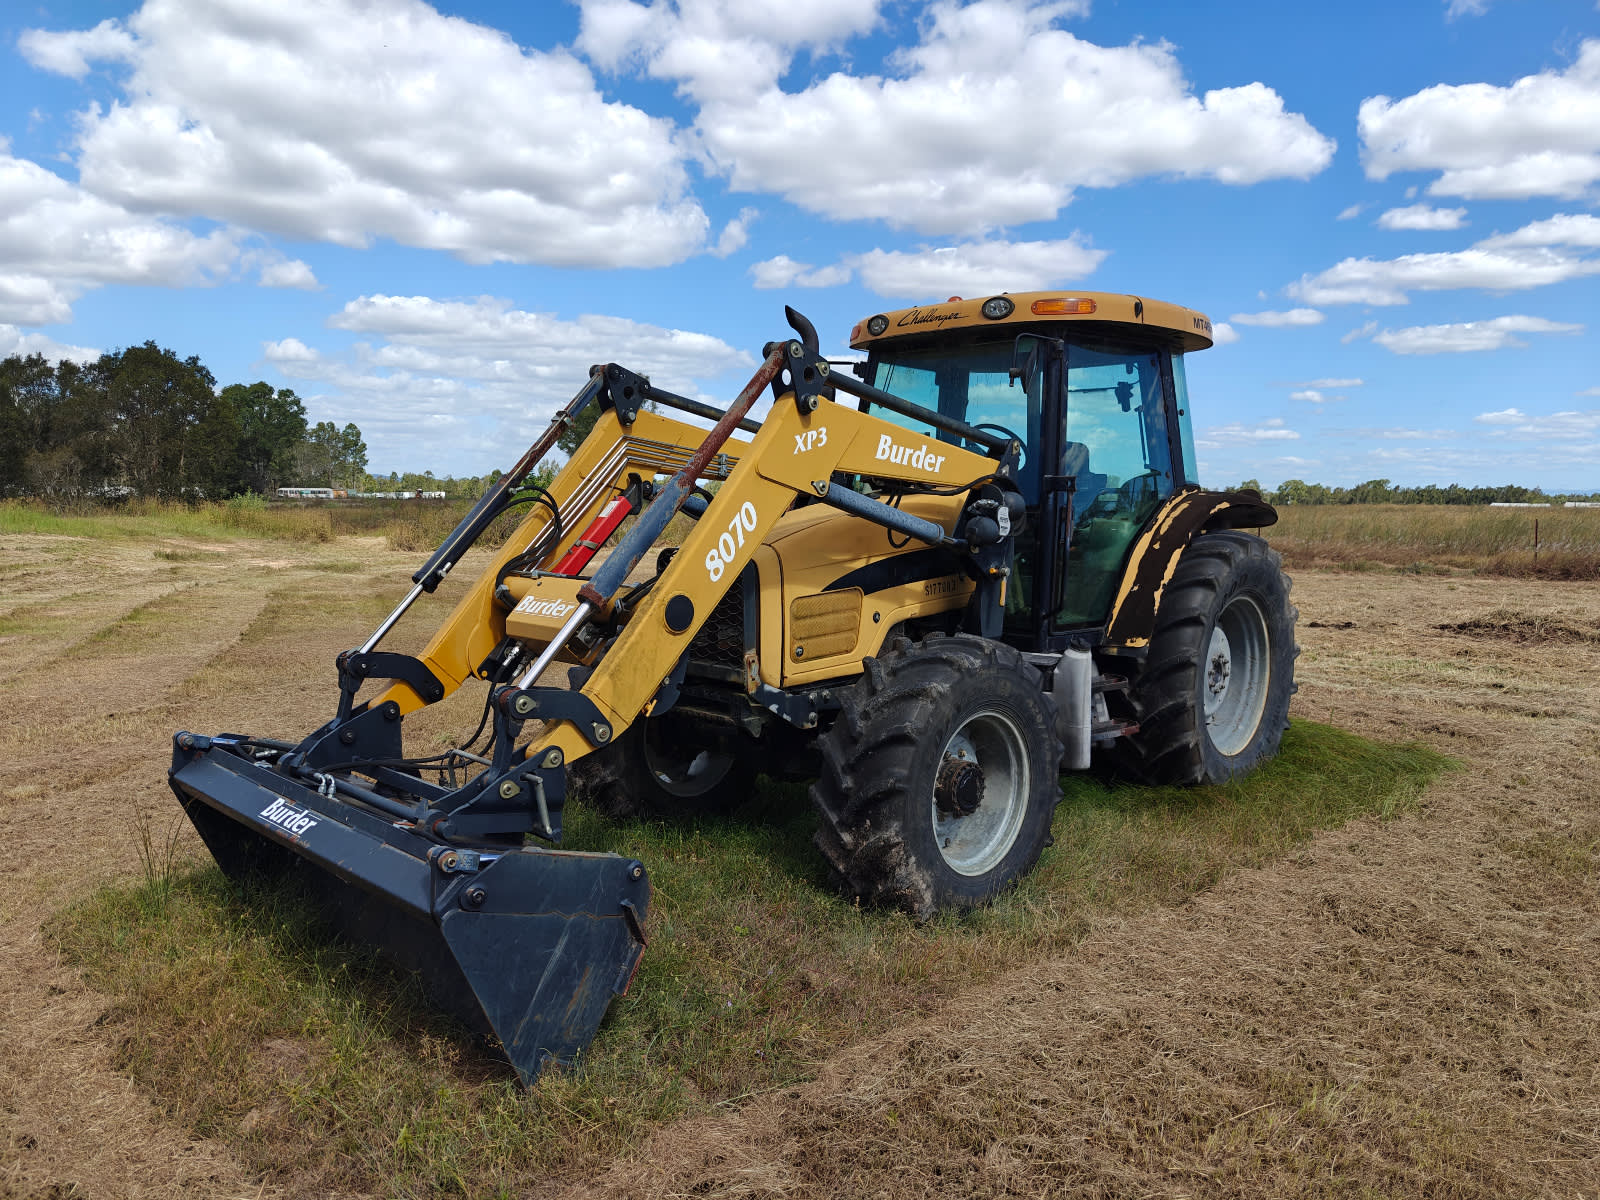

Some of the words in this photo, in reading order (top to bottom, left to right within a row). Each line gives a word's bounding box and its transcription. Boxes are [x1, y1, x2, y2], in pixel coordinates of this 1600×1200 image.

[793, 427, 827, 455] XP3
[875, 433, 945, 473] Burder
[705, 501, 757, 582] 8070
[515, 595, 575, 617] Burder
[259, 797, 318, 835] Burder
